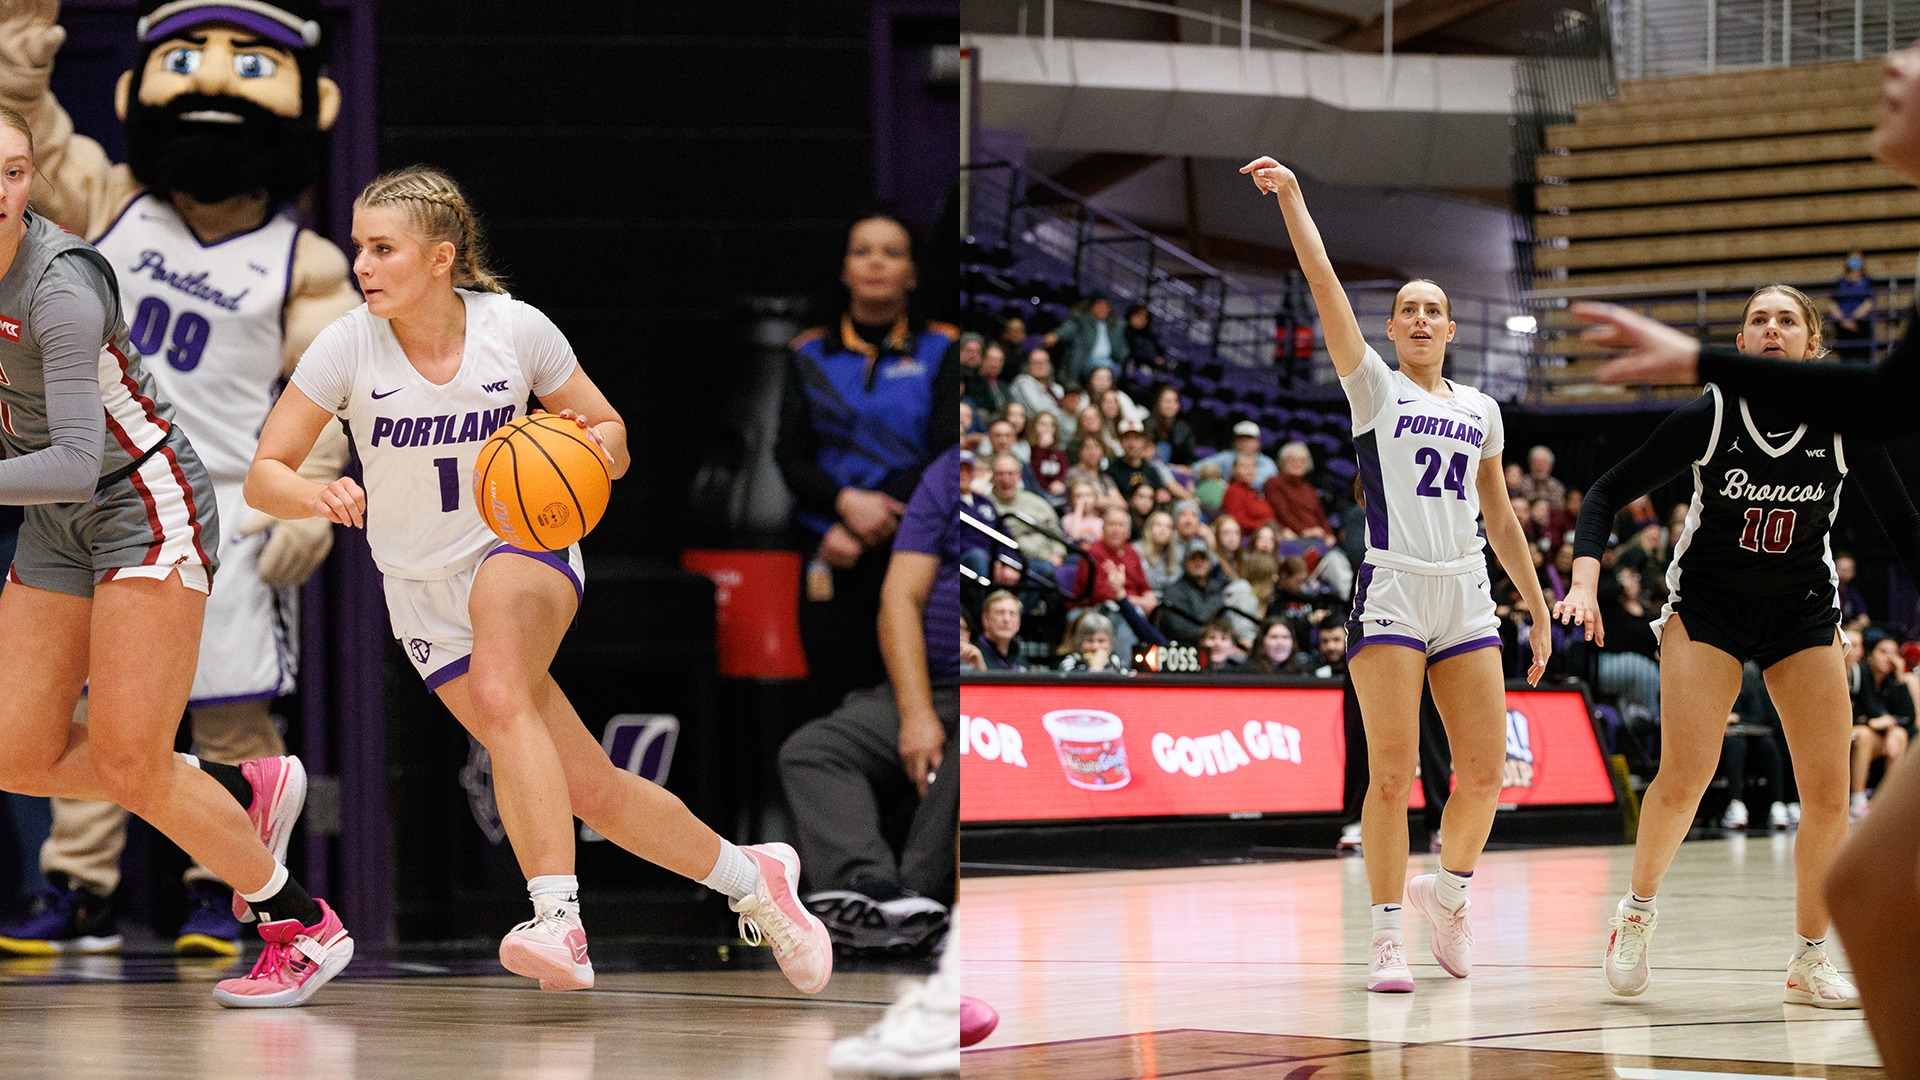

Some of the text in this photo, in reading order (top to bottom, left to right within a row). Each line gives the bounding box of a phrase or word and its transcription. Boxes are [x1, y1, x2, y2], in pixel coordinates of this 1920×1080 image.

[130, 250, 249, 311] Portland
[130, 297, 210, 372] 09
[481, 380, 509, 394] WCC
[1393, 415, 1484, 449] PORTLAND
[1804, 448, 1826, 458] WCC
[433, 457, 459, 513] 1
[1414, 446, 1469, 501] 24
[1719, 468, 1826, 502] Broncos
[1738, 507, 1797, 554] 10
[1151, 729, 1251, 778] GOTTA
[1242, 719, 1302, 765] GET
